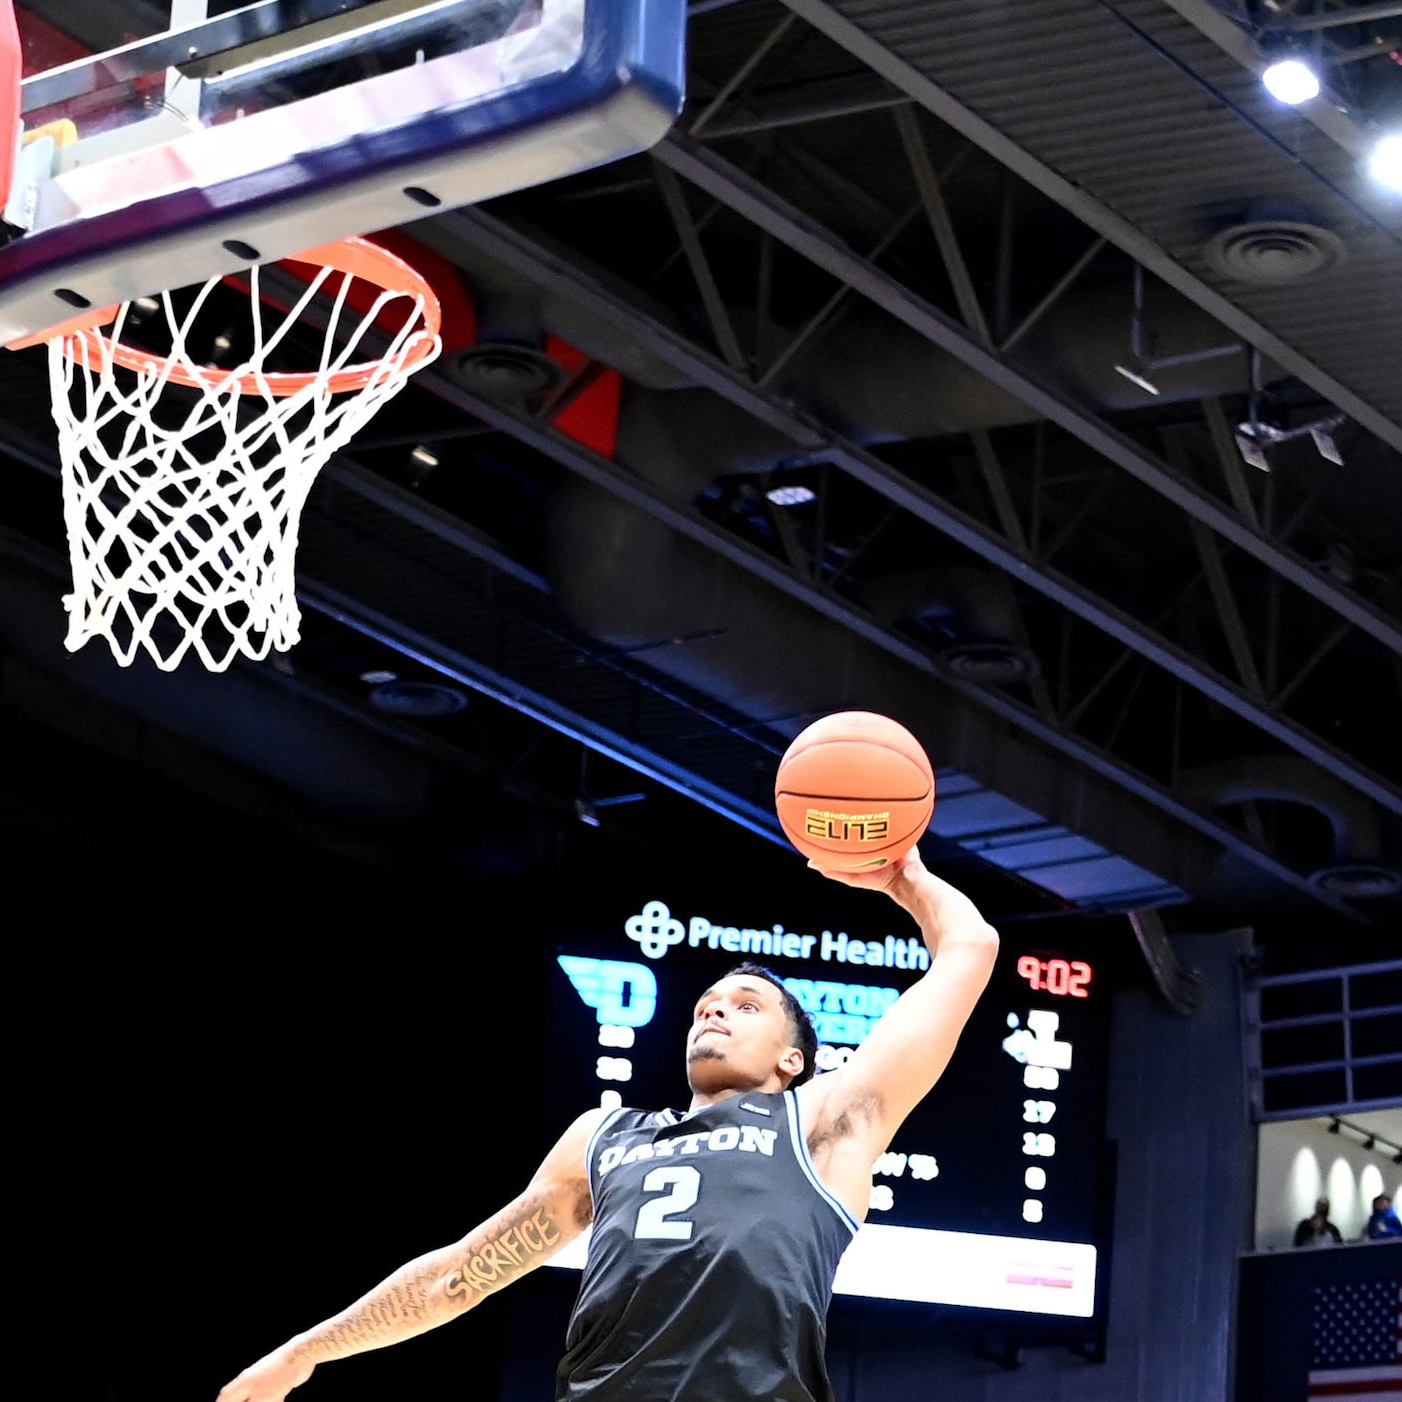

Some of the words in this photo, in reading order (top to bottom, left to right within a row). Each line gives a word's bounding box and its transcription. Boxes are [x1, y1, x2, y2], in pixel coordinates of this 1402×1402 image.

[806, 815, 889, 841] ELITE
[689, 916, 816, 959] Premier
[821, 930, 930, 971] Health
[1018, 956, 1092, 998] 9:02
[598, 1126, 778, 1176] DAYTON
[634, 1165, 701, 1240] 2
[445, 1206, 561, 1302] SACRIFICE
